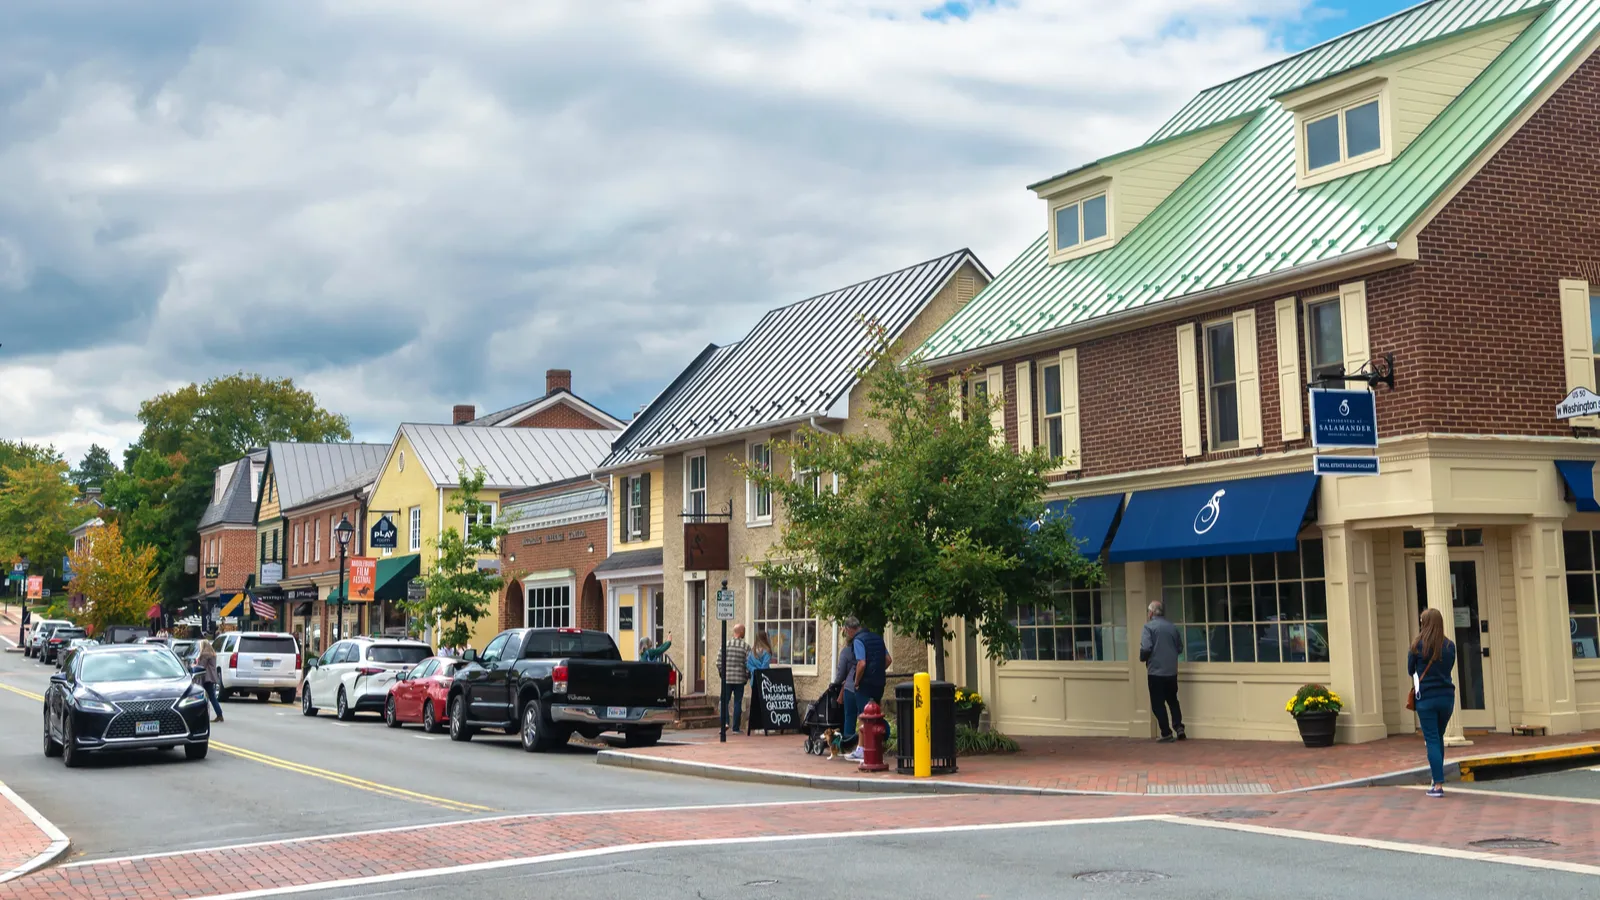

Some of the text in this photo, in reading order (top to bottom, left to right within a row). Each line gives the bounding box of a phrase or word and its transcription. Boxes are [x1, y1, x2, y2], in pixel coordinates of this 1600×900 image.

[1562, 400, 1597, 414] Washington
[356, 567, 369, 576] FILM
[352, 576, 371, 584] FESTIVAL
[762, 678, 787, 696] Artists
[766, 701, 794, 710] GALLERY
[770, 710, 791, 726] Open
